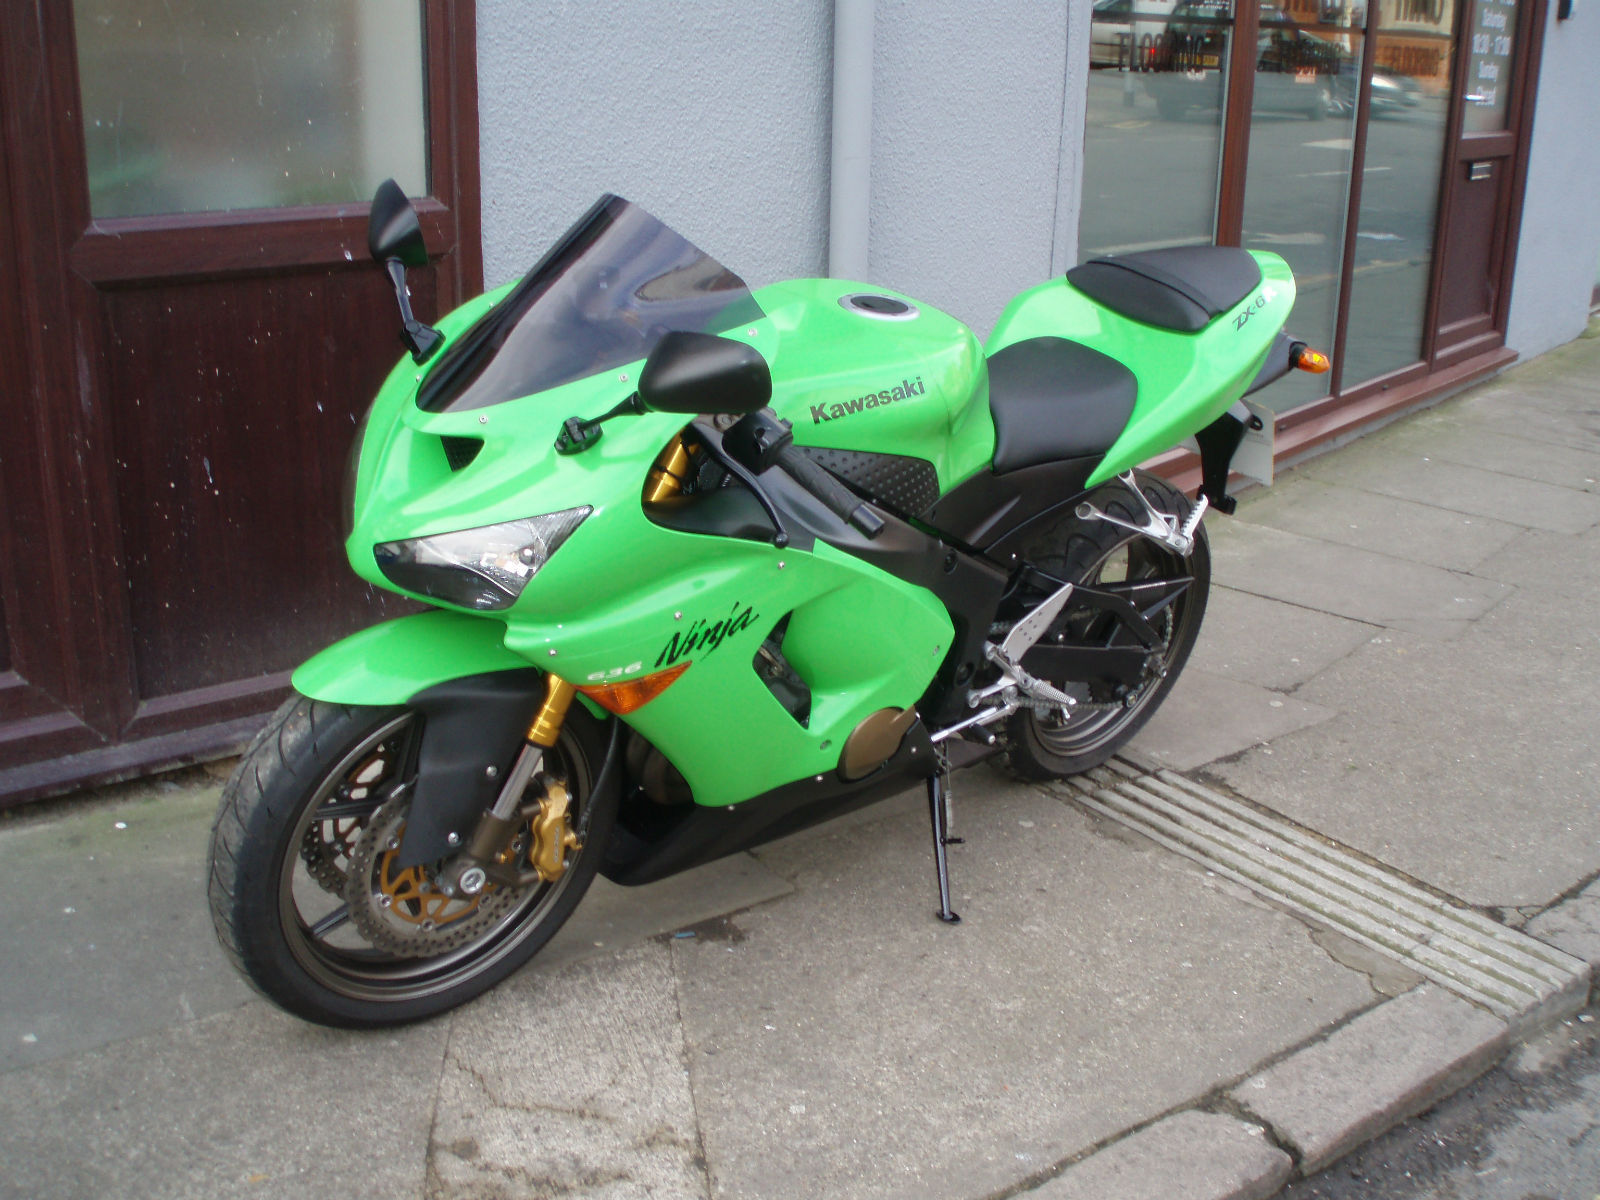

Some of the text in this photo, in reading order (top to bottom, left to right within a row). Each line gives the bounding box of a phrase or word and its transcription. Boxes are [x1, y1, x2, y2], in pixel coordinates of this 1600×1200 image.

[809, 376, 925, 425] Kawasaki
[653, 601, 760, 668] Ninja
[587, 660, 642, 682] 636
